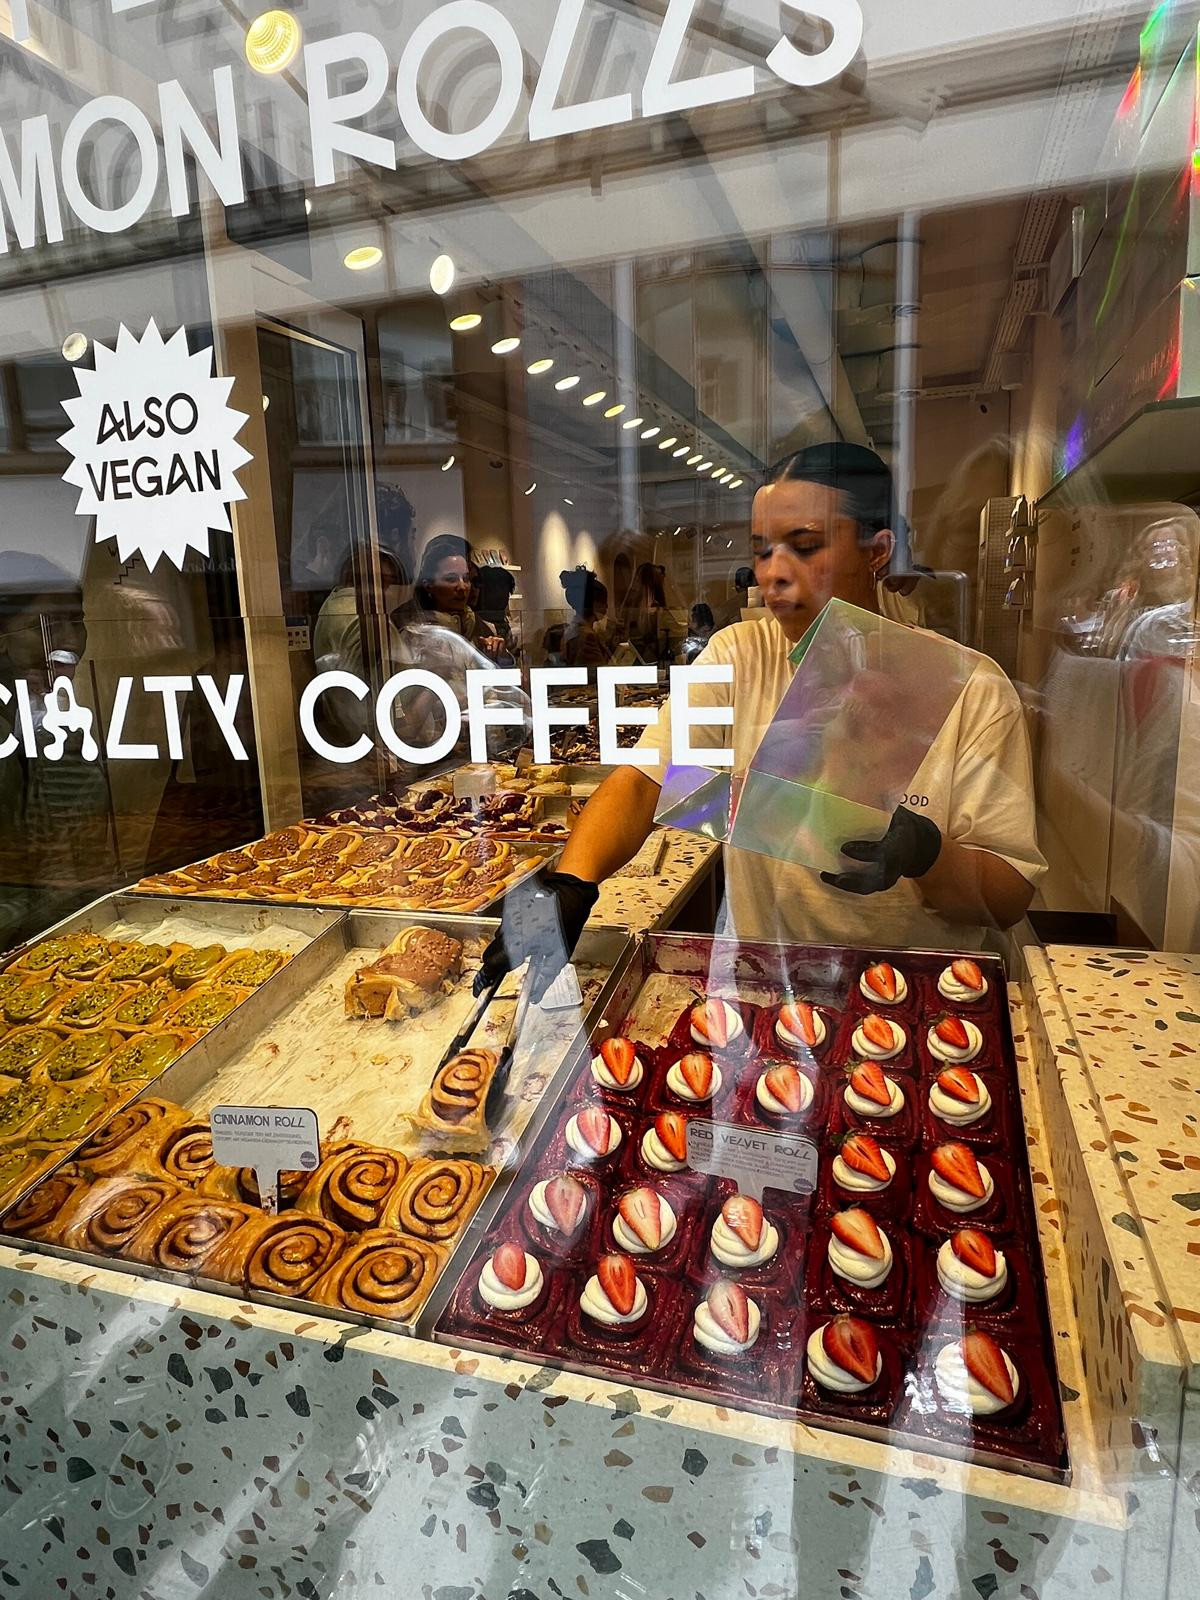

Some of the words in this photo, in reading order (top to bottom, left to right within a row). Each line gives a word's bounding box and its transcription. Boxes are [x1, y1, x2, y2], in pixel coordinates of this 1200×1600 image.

[304, 0, 864, 187] ROLLS
[96, 392, 199, 446] ALSO
[86, 449, 222, 502] VEGAN
[299, 664, 736, 767] COFFEE
[213, 1113, 270, 1127] CINNAMON
[275, 1116, 305, 1128] ROLL
[690, 1127, 714, 1140] RED
[721, 1133, 767, 1151] VELVET
[774, 1144, 812, 1160] ROLL
